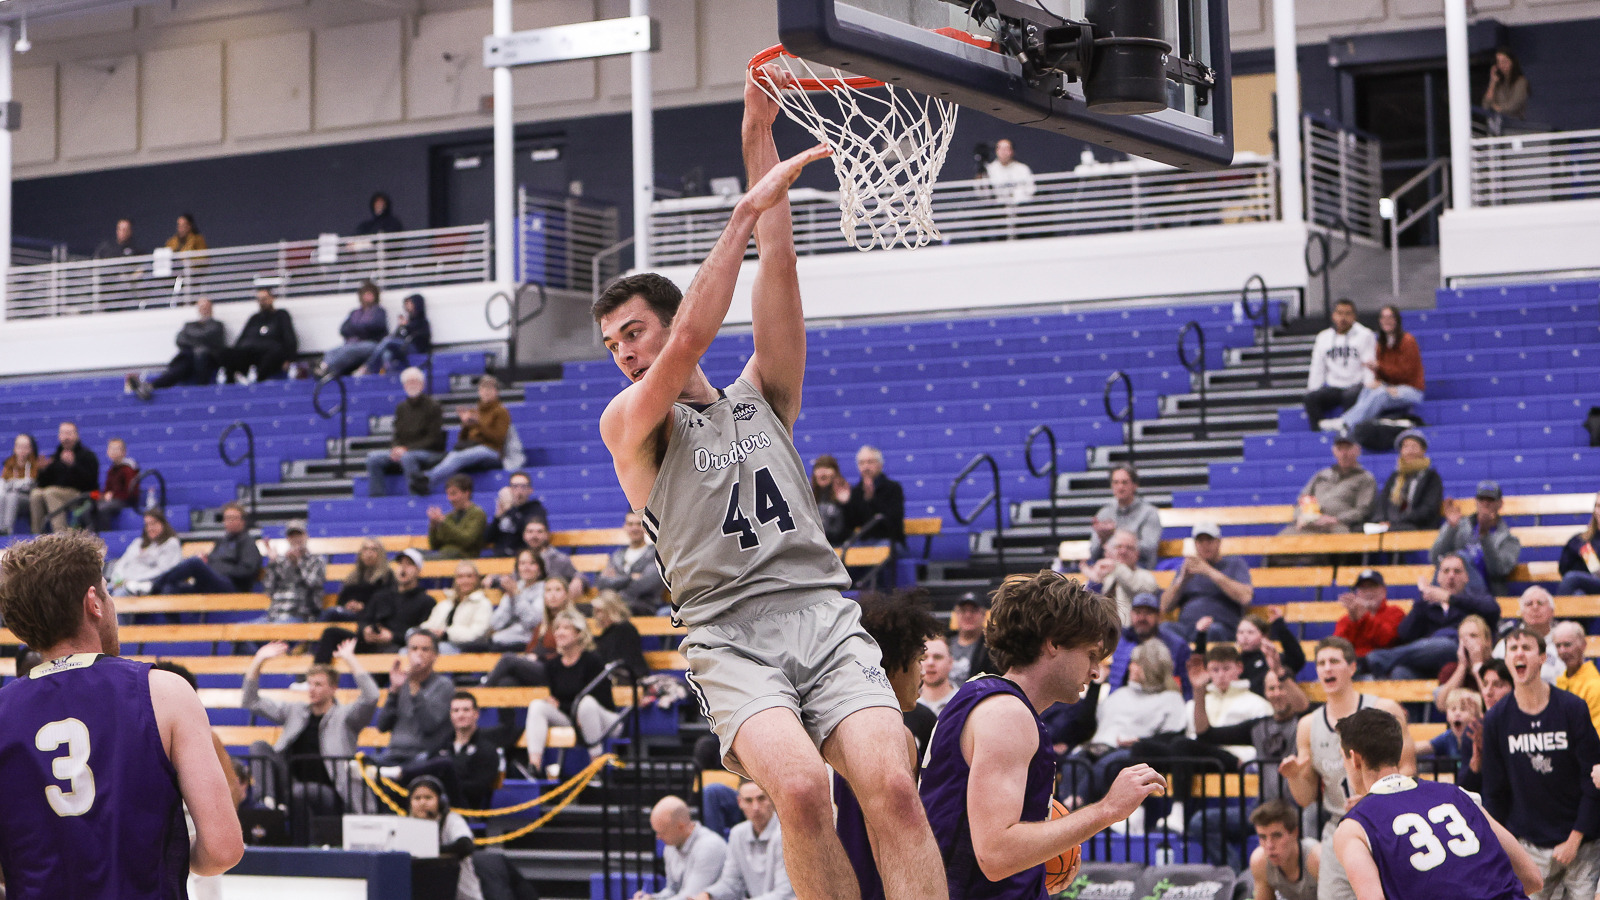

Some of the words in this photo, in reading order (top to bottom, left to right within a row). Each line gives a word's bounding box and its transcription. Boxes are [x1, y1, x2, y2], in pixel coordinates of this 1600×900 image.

[733, 404, 757, 421] RMAC
[721, 465, 797, 551] 44
[35, 717, 96, 817] 3
[1507, 731, 1569, 754] MINES
[1392, 803, 1480, 872] 33
